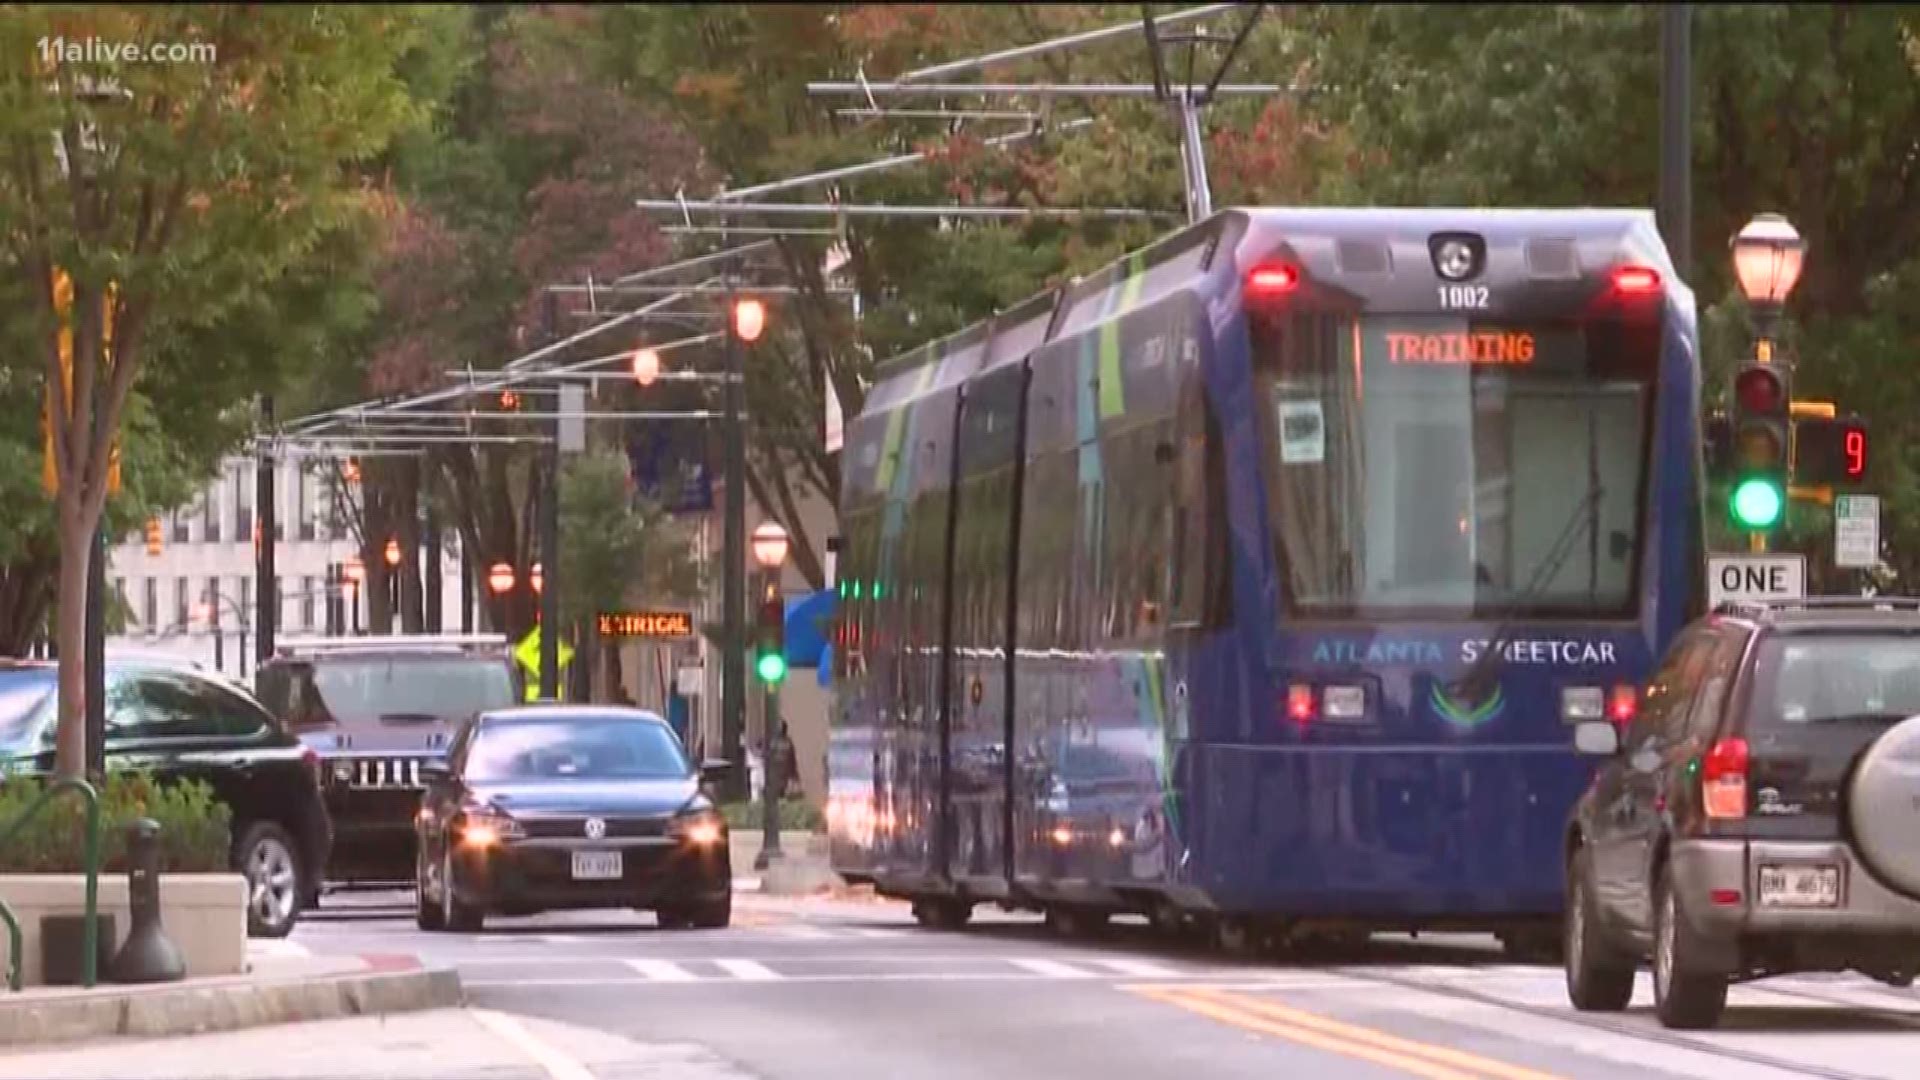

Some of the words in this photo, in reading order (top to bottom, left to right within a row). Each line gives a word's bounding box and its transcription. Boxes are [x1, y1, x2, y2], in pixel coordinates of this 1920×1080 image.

[1438, 286, 1489, 309] 1002
[1386, 332, 1535, 363] TRAINING
[1847, 431, 1863, 474] 9
[1721, 564, 1788, 593] ONE
[1312, 639, 1442, 663] ATLANTA
